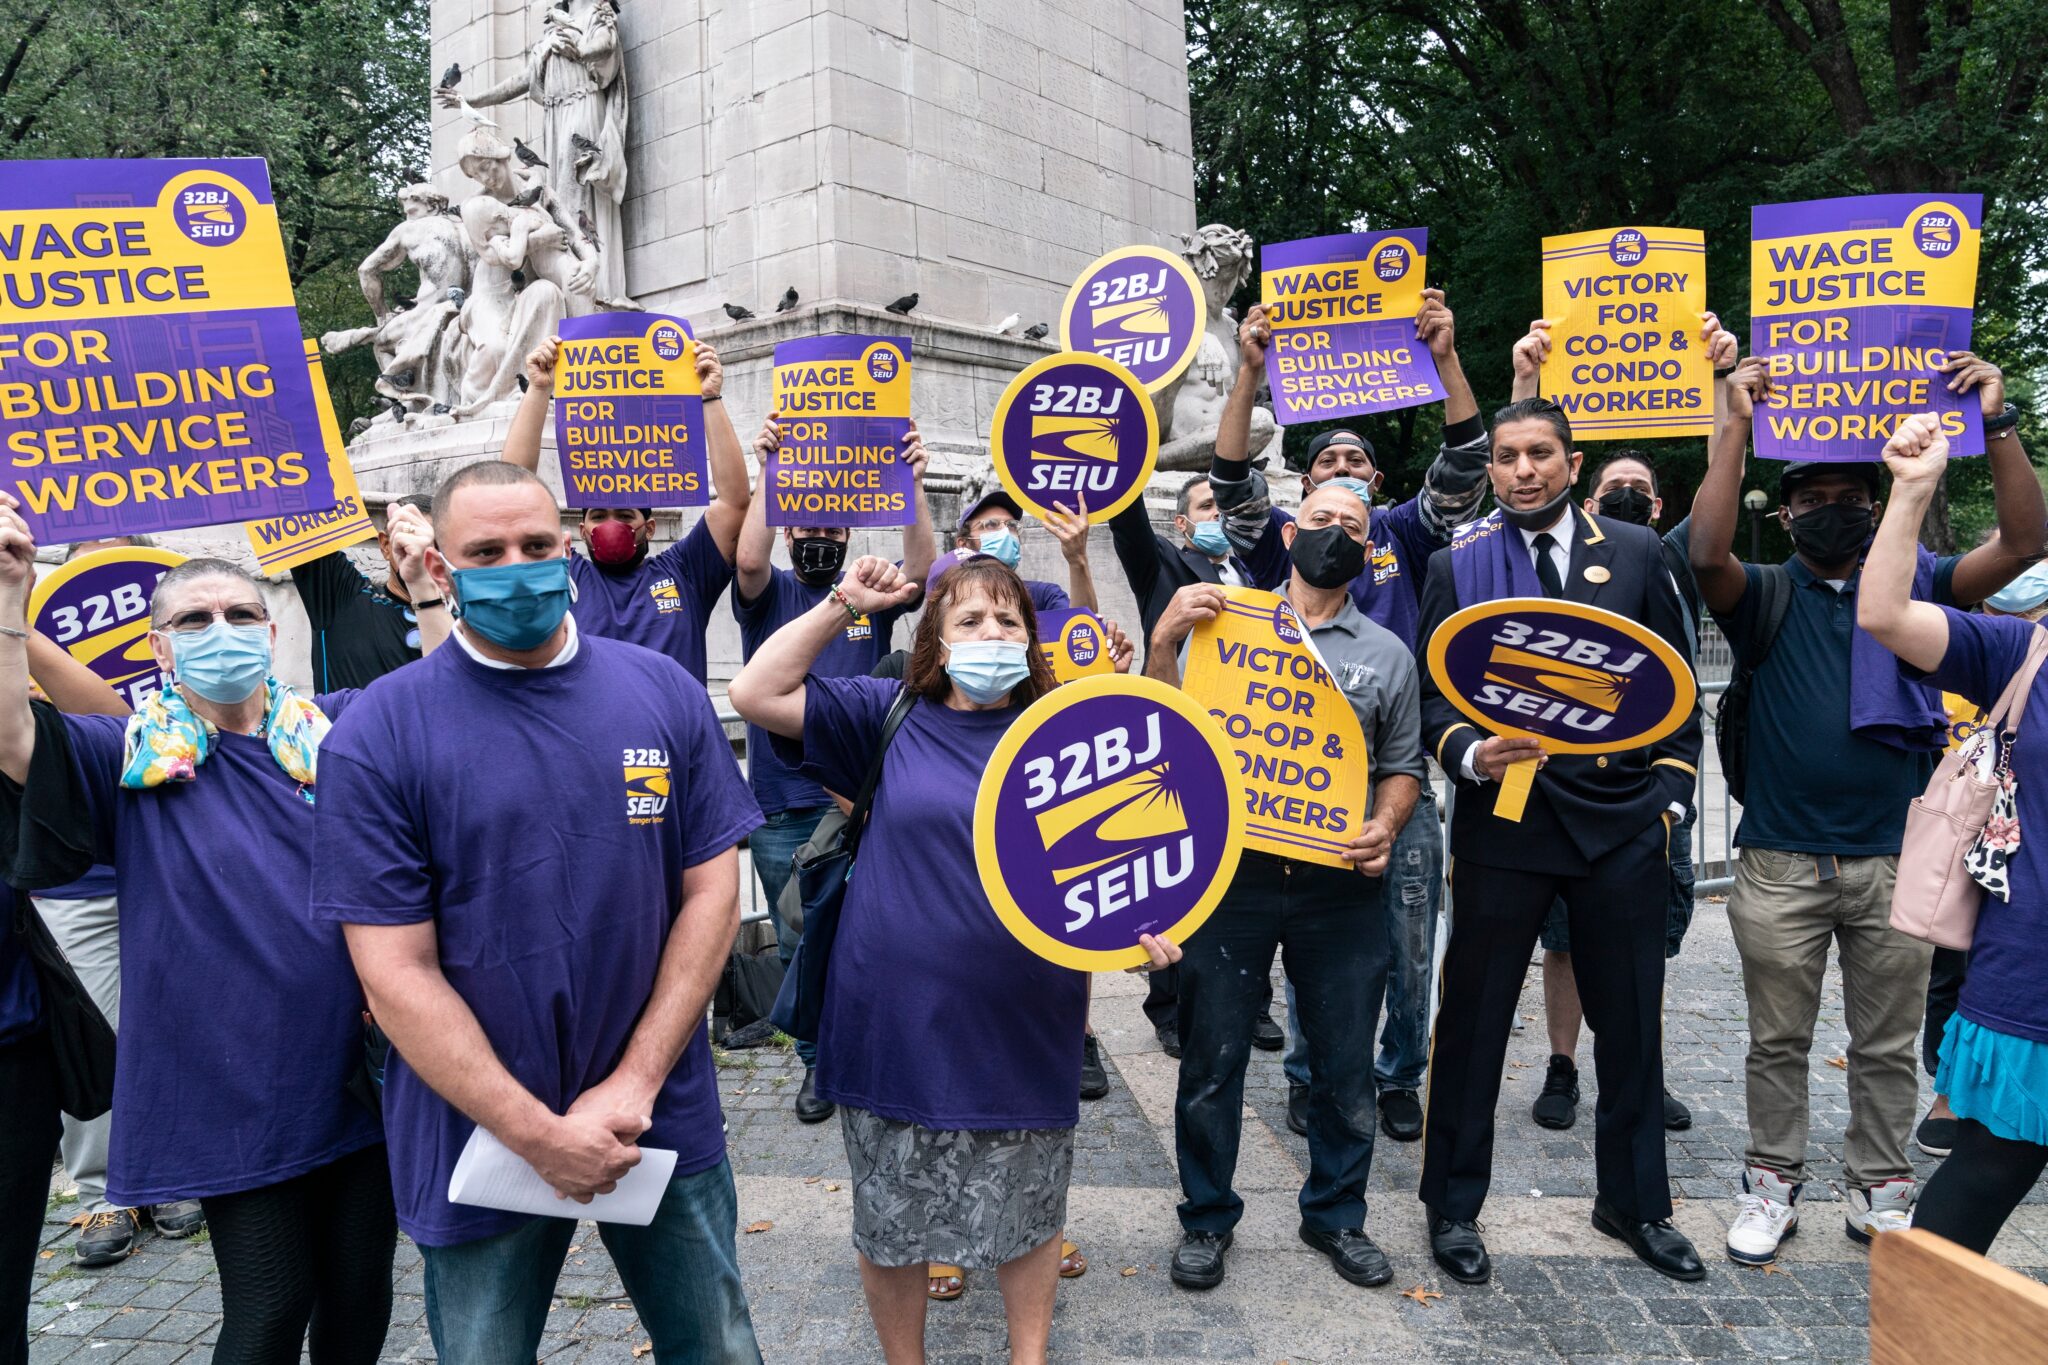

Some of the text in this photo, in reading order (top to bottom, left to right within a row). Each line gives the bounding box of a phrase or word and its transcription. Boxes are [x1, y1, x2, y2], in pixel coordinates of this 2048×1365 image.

[183, 191, 228, 205] 32BJ
[190, 224, 235, 238] SEIU
[1921, 217, 1952, 227] 32BJ
[1615, 234, 1641, 243] 32BJ
[1921, 242, 1951, 251] SEIU
[1380, 249, 1404, 259] 32BJ
[1615, 253, 1641, 262] SEIU
[1768, 237, 1893, 273] WAGE
[1272, 269, 1359, 296] WAGE
[1379, 268, 1403, 278] SEIU
[0, 265, 210, 309] USTICE
[1088, 268, 1168, 307] 32BJ
[1563, 272, 1689, 299] VICTORY
[1766, 270, 1925, 307] JUSTICE
[1271, 292, 1383, 323] JUSTICE
[1598, 302, 1659, 326] FOR
[657, 330, 677, 338] 32BJ
[1274, 331, 1332, 353] FOR
[1769, 316, 1850, 348] FOR
[658, 348, 679, 356] SEIU
[1565, 330, 1689, 357] CO-OP &
[563, 345, 640, 366] WAGE
[872, 353, 893, 361] 32BJ
[1277, 348, 1412, 374] BUILDING
[1769, 345, 1950, 378] BUILDING
[563, 369, 665, 391] JUSTICE
[780, 367, 854, 389] WAGE
[872, 371, 893, 379] SEIU
[1281, 369, 1400, 394] SERVICE
[1571, 359, 1682, 385] CONDO
[0, 364, 275, 420] BUILDING
[779, 391, 876, 412] JUSTICE
[1029, 384, 1124, 415] 32BJ
[1284, 383, 1433, 413] WORKERS
[1551, 387, 1702, 414] WORKERS
[1767, 379, 1931, 410] SERVICE
[565, 401, 615, 421] FOR
[566, 424, 688, 446] BUILDING
[779, 422, 828, 441] FOR
[1768, 410, 1967, 441] WORKS
[7, 411, 251, 467] SERVICE
[570, 449, 675, 470] SERVICE
[778, 446, 896, 465] BUILDING
[16, 452, 310, 515] WORKERS
[573, 472, 700, 493] WORKERS
[776, 470, 880, 489] SERVICE
[1027, 464, 1119, 491] SEIU
[776, 492, 906, 512] WORKERS
[52, 571, 167, 643] 32B
[657, 597, 681, 610] SEIU
[847, 626, 871, 638] SEIU
[1072, 628, 1092, 639] 32BJ
[1278, 627, 1300, 639] SEIU
[1073, 650, 1095, 661] SEIU
[1491, 620, 1648, 673] 32BJ
[1245, 681, 1315, 718] FOR
[1473, 684, 1615, 732] SEIU
[622, 748, 670, 767] 32BJ
[1322, 733, 1344, 760] &
[1024, 711, 1162, 810] 32BJ
[626, 797, 668, 816] SEIU
[1245, 787, 1349, 833] RKERS
[1063, 835, 1194, 934] SEIU
